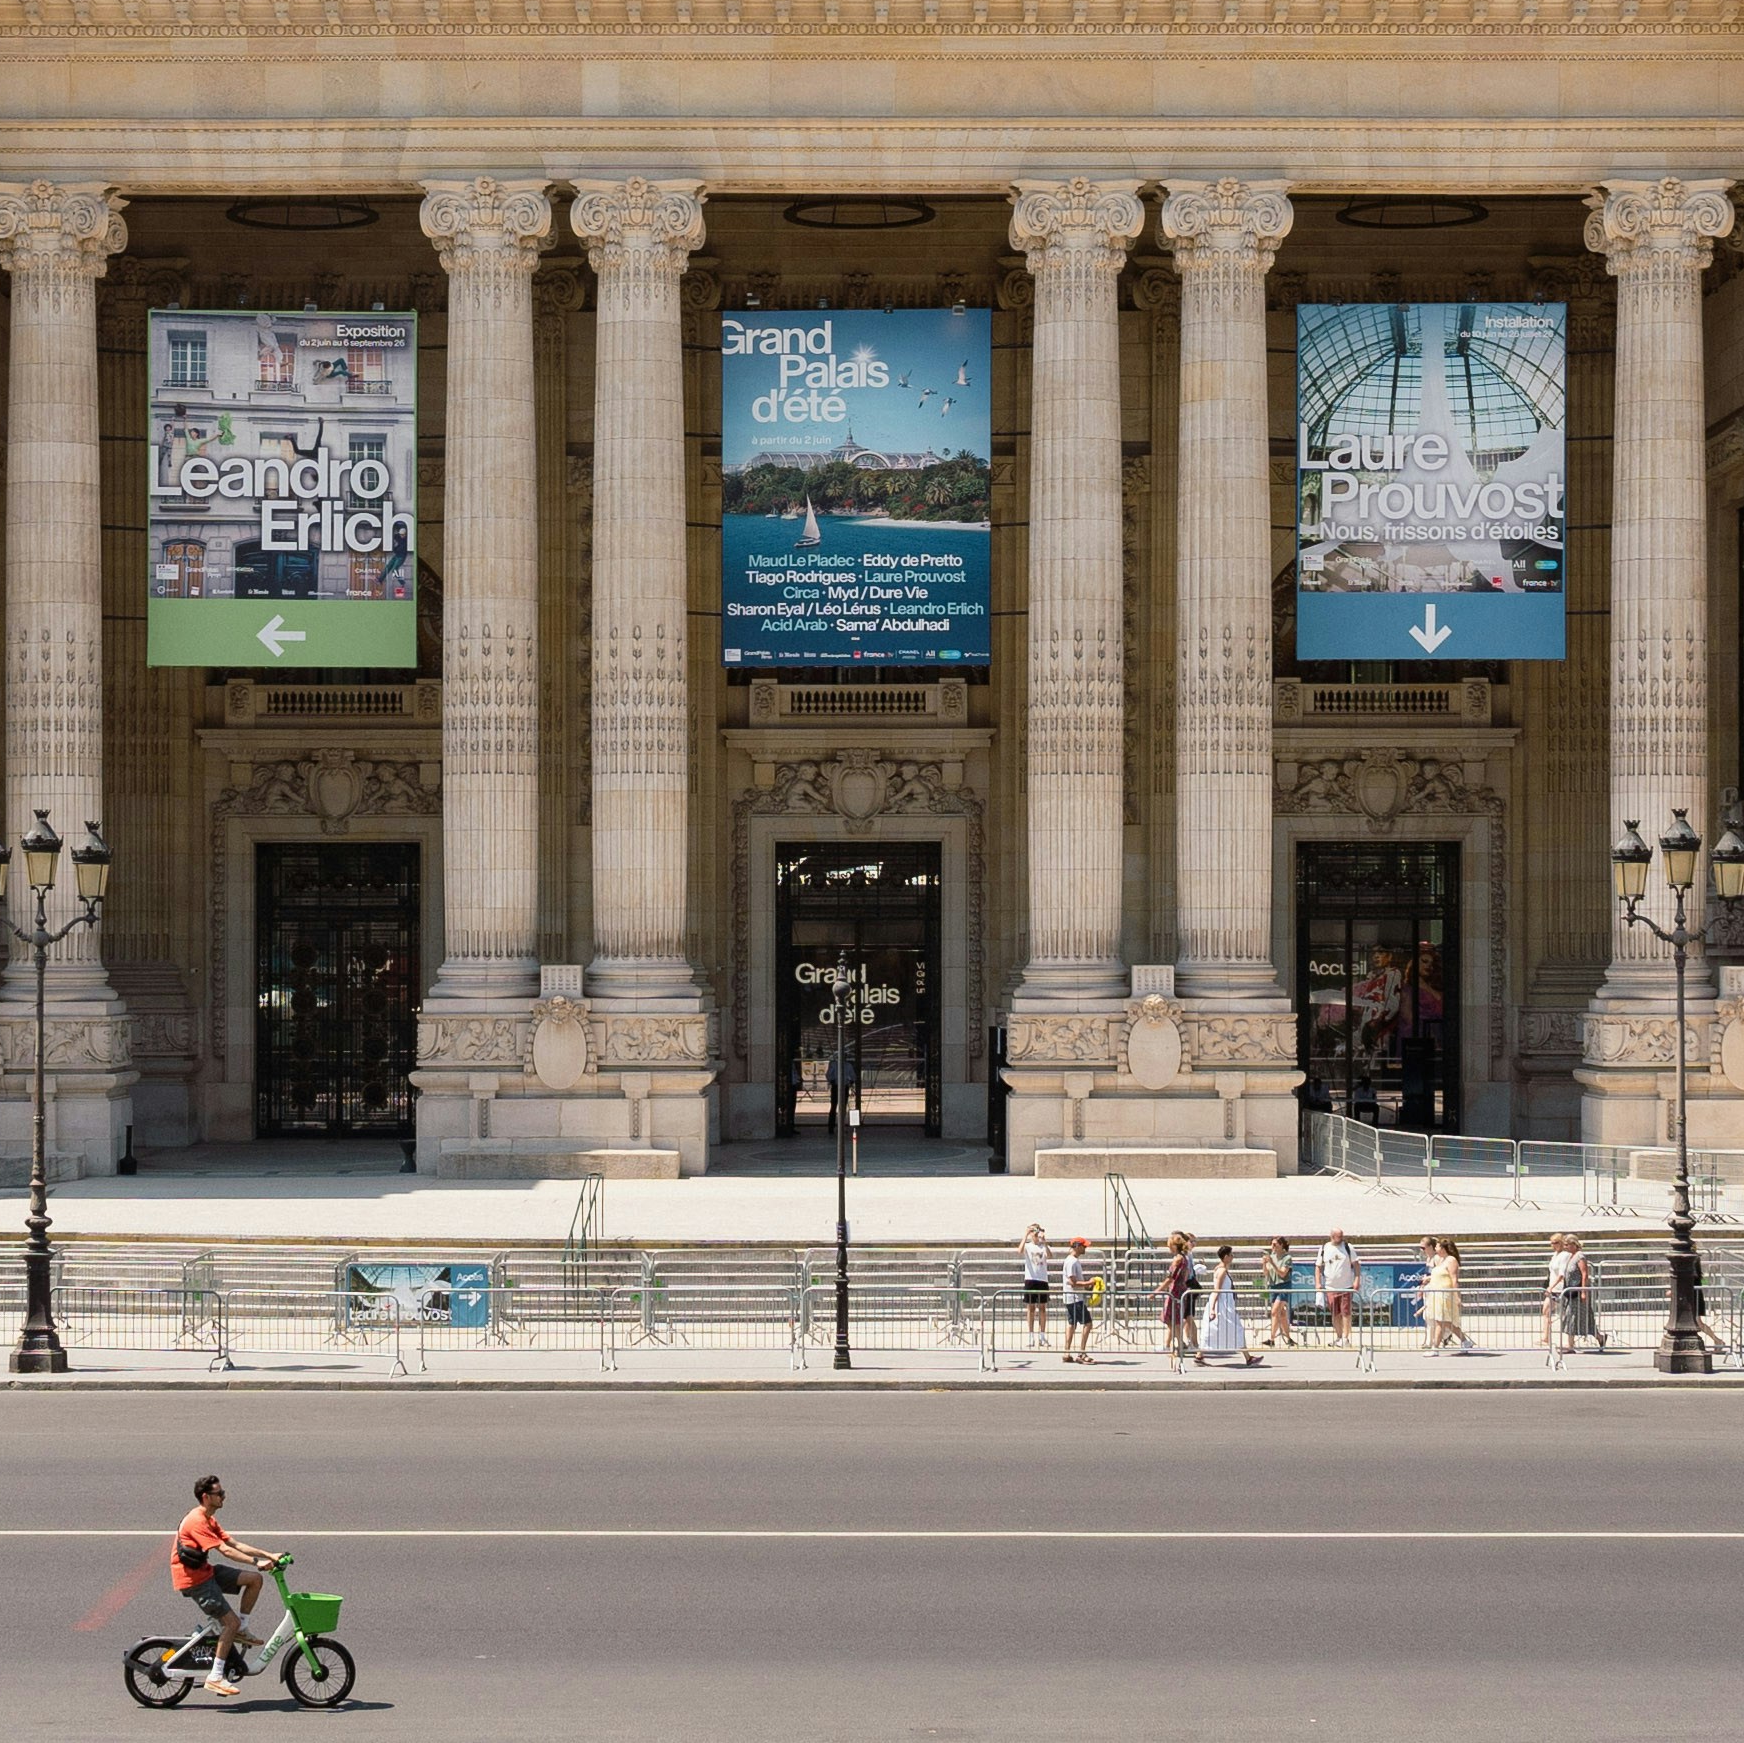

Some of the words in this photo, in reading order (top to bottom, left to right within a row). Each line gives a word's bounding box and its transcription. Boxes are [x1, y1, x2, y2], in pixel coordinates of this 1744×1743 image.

[1485, 316, 1554, 328] Installation
[336, 324, 406, 339] Exposition
[722, 320, 832, 355] Grand
[1460, 330, 1471, 338] du
[1482, 330, 1496, 339] juin
[299, 339, 310, 347] du
[311, 339, 316, 347] 2
[316, 339, 332, 348] juin
[343, 339, 349, 347] 6
[350, 339, 393, 348] septembre
[394, 339, 406, 347] 26
[779, 354, 890, 389] Palais
[751, 388, 847, 423] d'été
[751, 436, 757, 445] à
[760, 436, 787, 446] partir
[789, 436, 802, 445] du
[804, 436, 812, 445] 2
[812, 436, 832, 446] juin
[1300, 422, 1448, 471] Laure
[150, 445, 390, 499] Leandro
[1322, 471, 1564, 519] Prouvost
[261, 499, 414, 552] Erlich
[1320, 521, 1379, 542] Nous,
[1383, 522, 1468, 540] frissons
[1471, 521, 1559, 540] d'étoiles
[748, 554, 787, 567] Maud
[789, 554, 806, 567] Le
[808, 554, 855, 567] Pladec
[863, 554, 898, 569] Eddy
[900, 554, 919, 567] de
[920, 554, 963, 567] Pretto
[745, 570, 785, 586] Tiago
[786, 570, 856, 586] Rodrigues
[864, 570, 903, 583] Laure
[904, 570, 966, 583] Prouvost
[783, 586, 819, 599] Circa
[828, 586, 859, 601] Myd
[869, 586, 903, 599] Dure
[904, 586, 929, 599] Vie
[727, 602, 775, 616] Sharon
[777, 602, 805, 617] Eyal
[815, 602, 842, 615] Léo
[843, 602, 881, 615] Lérus
[890, 602, 946, 615] Leandro
[947, 602, 984, 615] Erlich
[761, 618, 793, 632] Acid
[794, 618, 828, 632] Arab
[836, 618, 880, 632] Sama'
[880, 618, 950, 632] Abdulhadi
[258, 1635, 284, 1664] Lime
